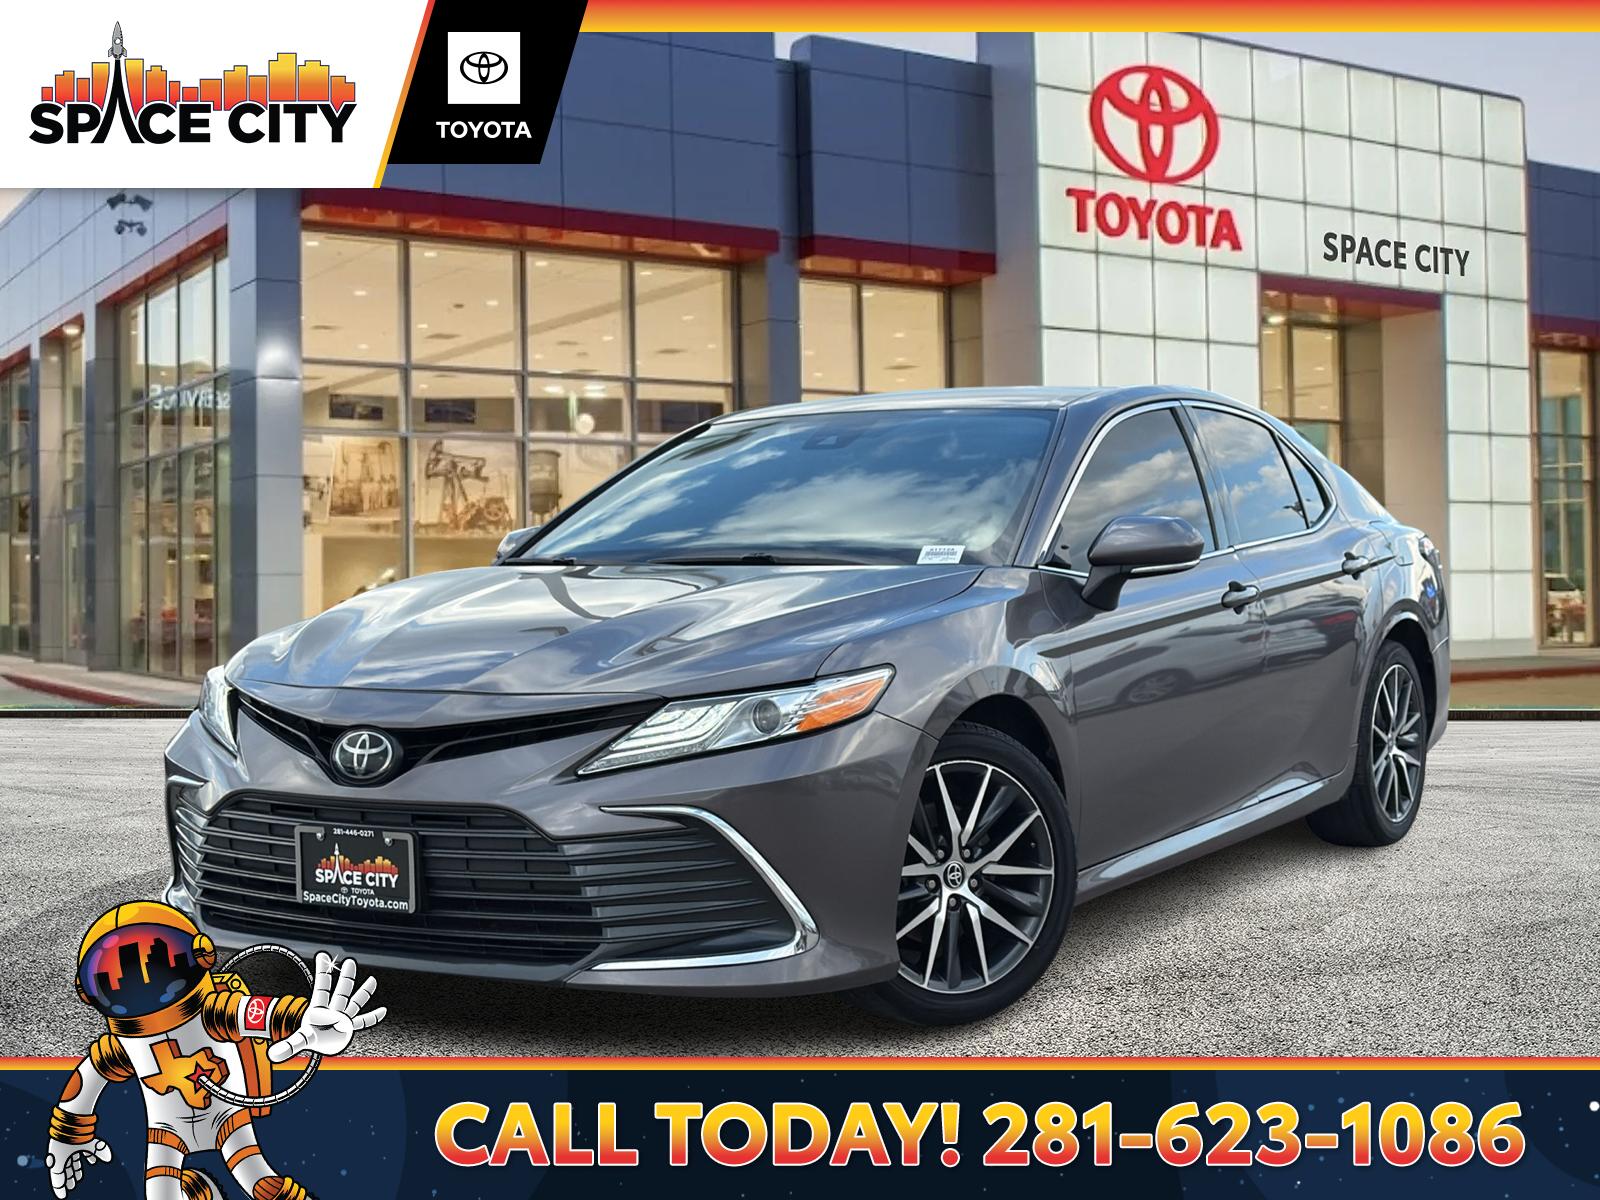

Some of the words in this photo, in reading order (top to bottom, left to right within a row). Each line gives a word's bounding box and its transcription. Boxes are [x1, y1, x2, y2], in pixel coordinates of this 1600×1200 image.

[1066, 187, 1242, 251] TOYOTA
[1323, 232, 1407, 270] SPACE
[1414, 244, 1470, 276] CITY
[333, 827, 375, 838] 281-446-0271
[365, 872, 399, 888] CITY
[303, 890, 409, 910] SpaceCityToyota.com
[351, 887, 375, 895] TOYOTA
